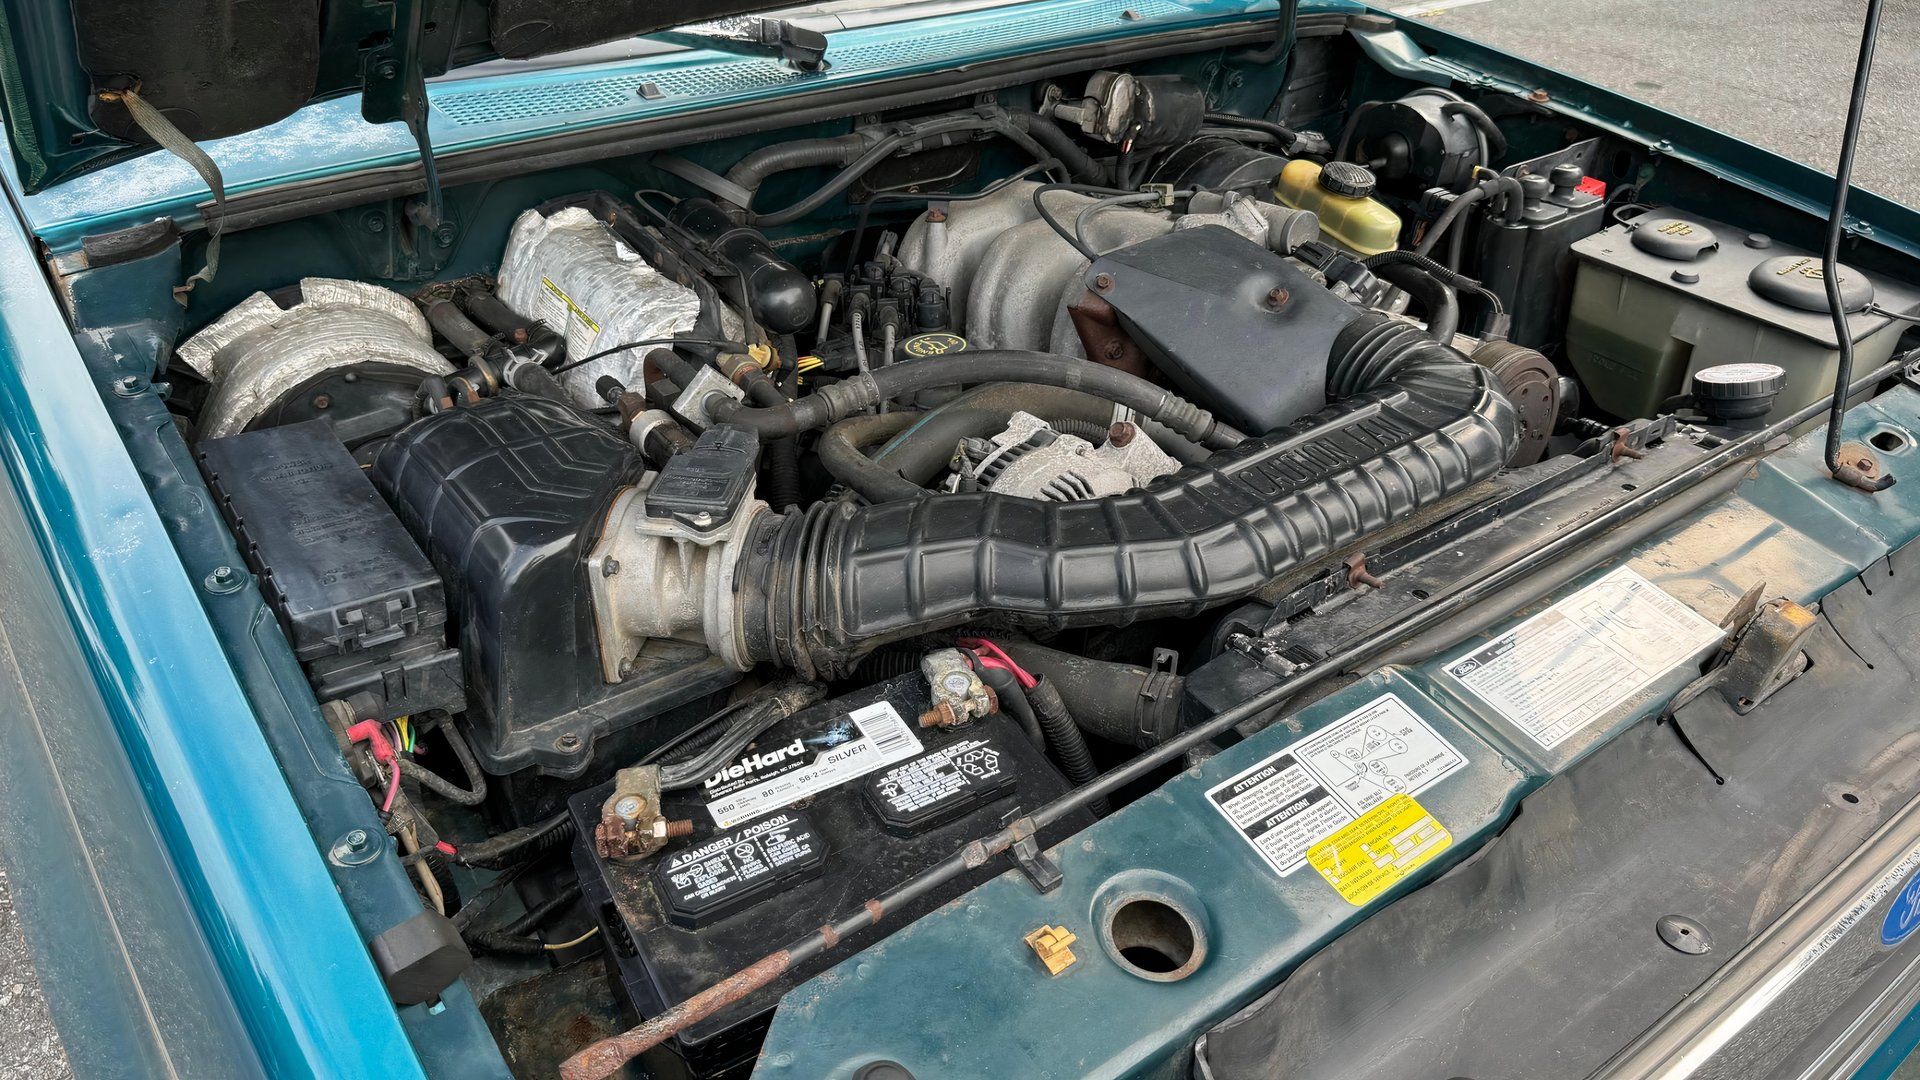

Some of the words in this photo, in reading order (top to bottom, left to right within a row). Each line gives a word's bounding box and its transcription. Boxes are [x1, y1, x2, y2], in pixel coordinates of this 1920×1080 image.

[1239, 438, 1358, 495] CAUTION
[1343, 416, 1412, 451] FAN
[827, 744, 866, 763] SILVER
[703, 739, 804, 787] DieHard
[711, 787, 732, 798] Advance
[745, 777, 760, 785] Parts,
[760, 770, 779, 779] Raleigh,
[798, 771, 818, 783] 58-2
[1233, 766, 1276, 792] ATTENTION
[709, 780, 737, 794] Distributed
[761, 788, 774, 797] 80
[1226, 800, 1241, 809] When
[1241, 788, 1263, 802] changing
[1268, 776, 1285, 786] adding
[1284, 768, 1299, 777] engine
[1239, 799, 1256, 809] remove
[1264, 786, 1280, 796] engine
[1267, 791, 1284, 802] engine
[717, 803, 734, 814] 550
[1266, 798, 1309, 827] ATTENTION!
[1240, 816, 1254, 824] when
[1259, 836, 1271, 844] Lors
[1283, 819, 1300, 831] vidange
[1316, 800, 1332, 812] appoint
[1265, 837, 1282, 850] d'huile
[1302, 816, 1318, 827] retirer
[1318, 804, 1337, 818] d'abord
[1316, 827, 1327, 835] Voir
[1332, 815, 1347, 825] Guide
[1348, 825, 1359, 833] LEAK
[682, 837, 733, 862] DANGER
[743, 814, 787, 837] POISON
[766, 838, 795, 853] SULFURIC
[796, 832, 810, 842] ACID
[1367, 835, 1383, 846] ENGINE
[1388, 825, 1398, 833] DYE
[772, 847, 800, 862] BLINDNESS
[774, 855, 794, 866] SEVERE
[794, 847, 811, 858] BURNS
[781, 843, 798, 853] CAUSE
[1275, 842, 1288, 853] jauge
[1375, 843, 1390, 854] OTHER
[703, 854, 726, 867] SHIELD
[706, 861, 723, 872] EYES
[740, 859, 761, 871] SPARKS
[742, 855, 754, 864] NO
[694, 865, 727, 883] EXPLOSIVE
[742, 863, 763, 875] FLAMES
[1337, 864, 1358, 879] COOLANT
[1356, 859, 1367, 867] DYE
[697, 876, 717, 888] GASES
[1338, 882, 1351, 892] DATE
[1349, 868, 1372, 884] INSTALLED
[1346, 883, 1368, 899] LOCATION
[1372, 869, 1390, 882] SERVICE
[683, 892, 694, 900] CAN
[694, 885, 710, 895] CAUSE
